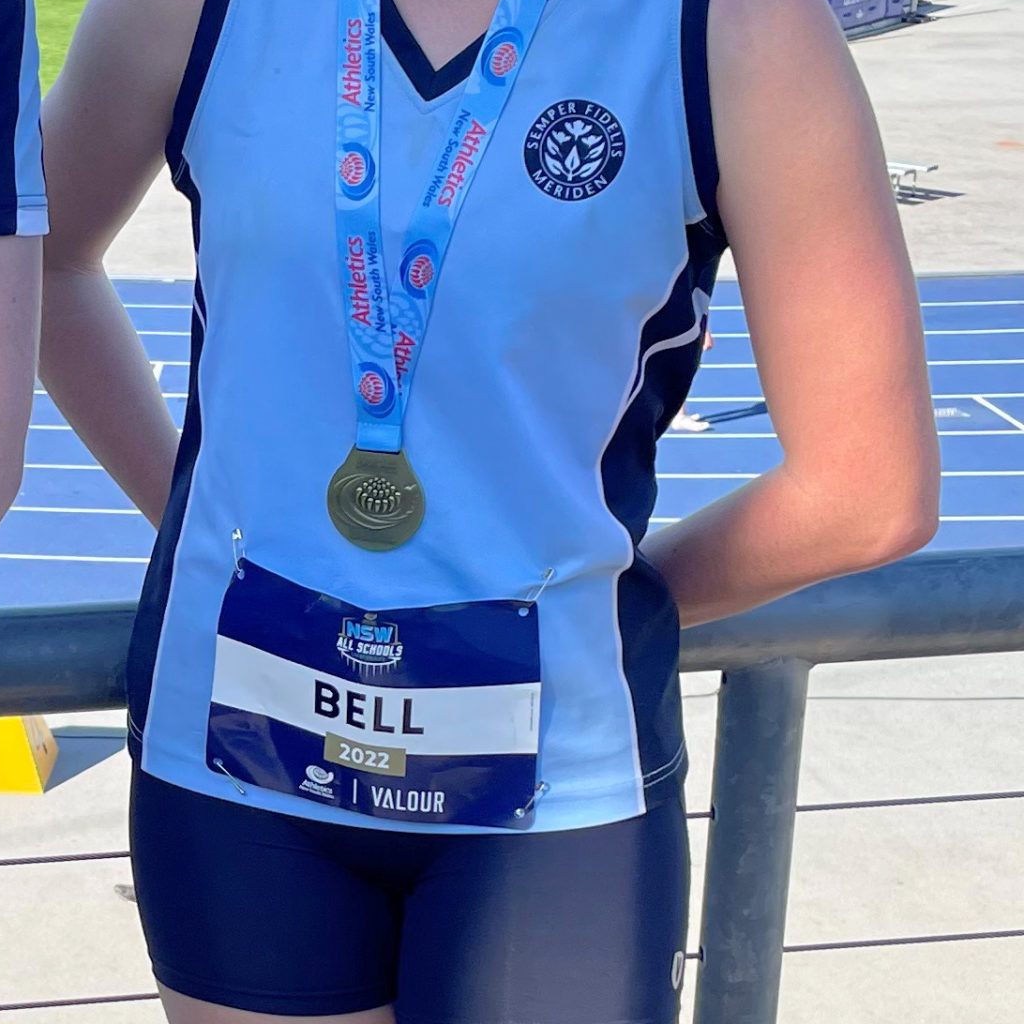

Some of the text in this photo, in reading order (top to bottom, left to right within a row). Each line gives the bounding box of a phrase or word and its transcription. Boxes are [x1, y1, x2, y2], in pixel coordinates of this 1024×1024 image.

[342, 18, 362, 106] Athletics
[364, 12, 376, 112] New South Wales
[527, 102, 623, 157] SEMPER FIDELIS
[423, 109, 471, 207] New South Wales
[438, 119, 486, 207] Athletics
[532, 169, 607, 199] MERIDEN
[345, 236, 372, 326] Athletics
[367, 231, 386, 333] New South Wales
[337, 637, 403, 656] ALL SCHOOLS
[347, 621, 393, 643] NSW
[315, 679, 424, 734] BELL
[339, 743, 390, 769] 2022
[371, 786, 445, 813] VALOUR
